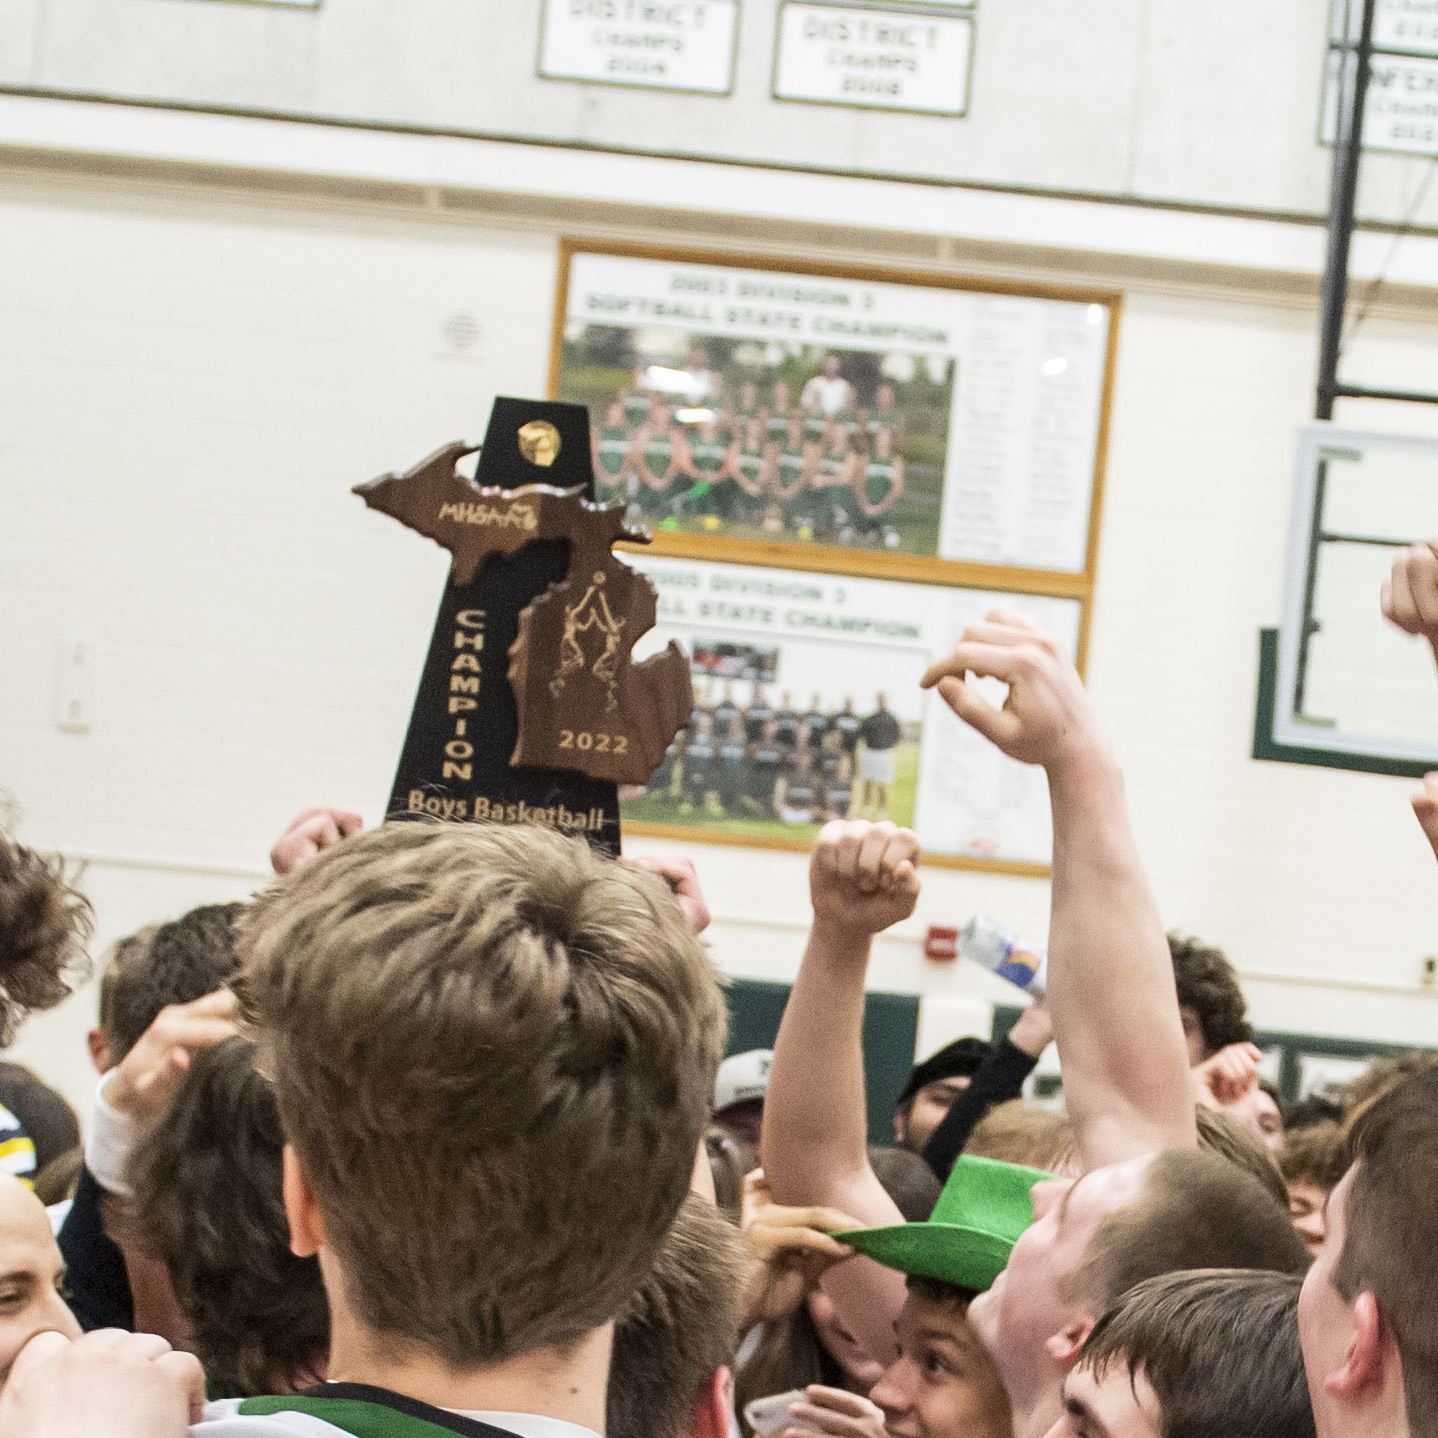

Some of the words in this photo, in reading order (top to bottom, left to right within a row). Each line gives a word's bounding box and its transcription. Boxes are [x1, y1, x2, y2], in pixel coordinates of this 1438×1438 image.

[804, 15, 939, 50] DISTRICT
[724, 305, 802, 333] STATE
[441, 609, 486, 781] CHAMPION
[559, 729, 630, 755] 2022
[408, 789, 467, 818] Boys
[473, 796, 605, 831] Basketball
